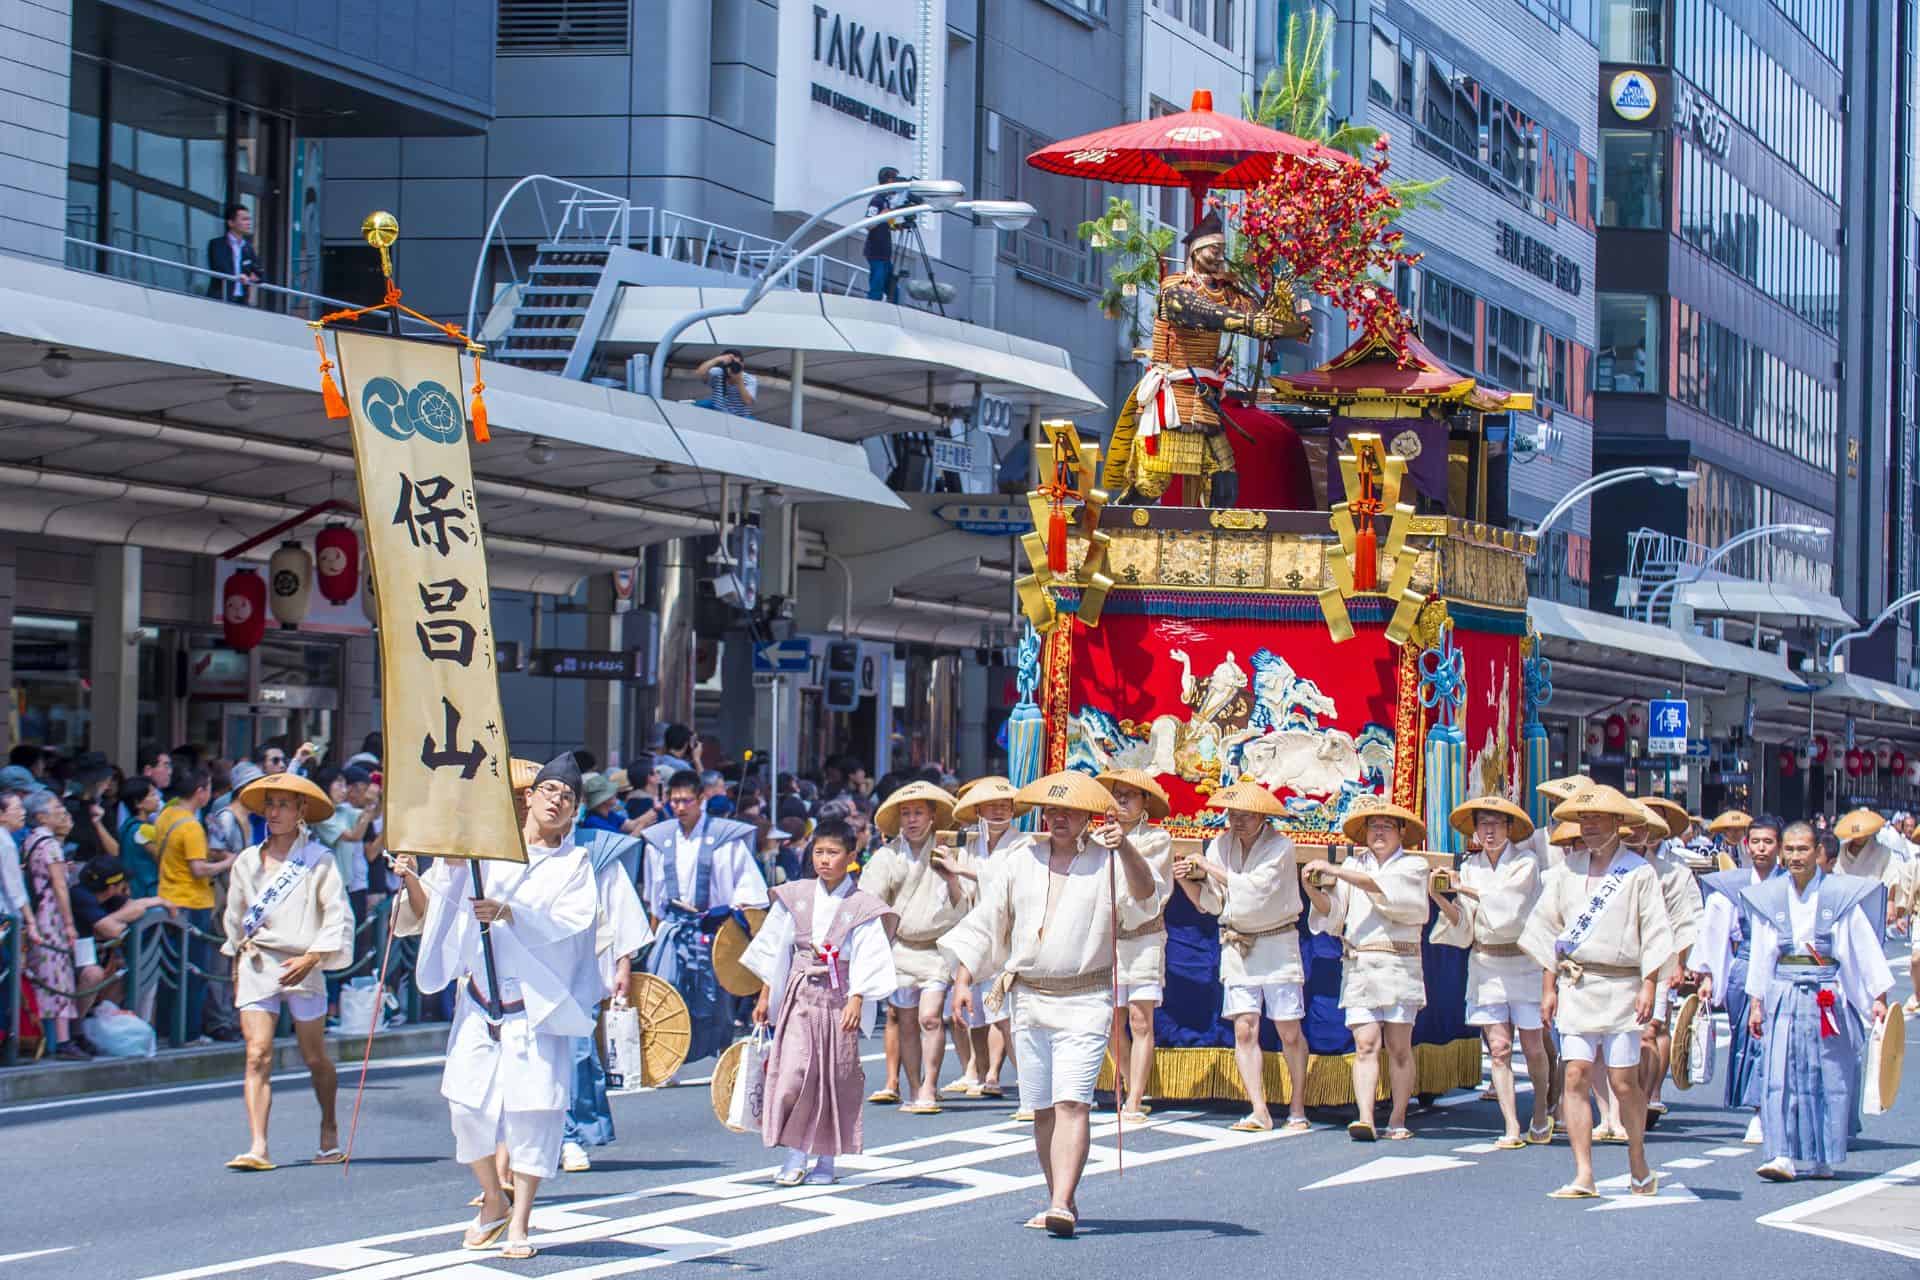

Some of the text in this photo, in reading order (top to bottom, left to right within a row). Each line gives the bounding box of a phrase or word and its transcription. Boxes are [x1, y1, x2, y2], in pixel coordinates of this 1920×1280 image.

[391, 471, 488, 780] 保昌山
[1655, 706, 1682, 733] 停
